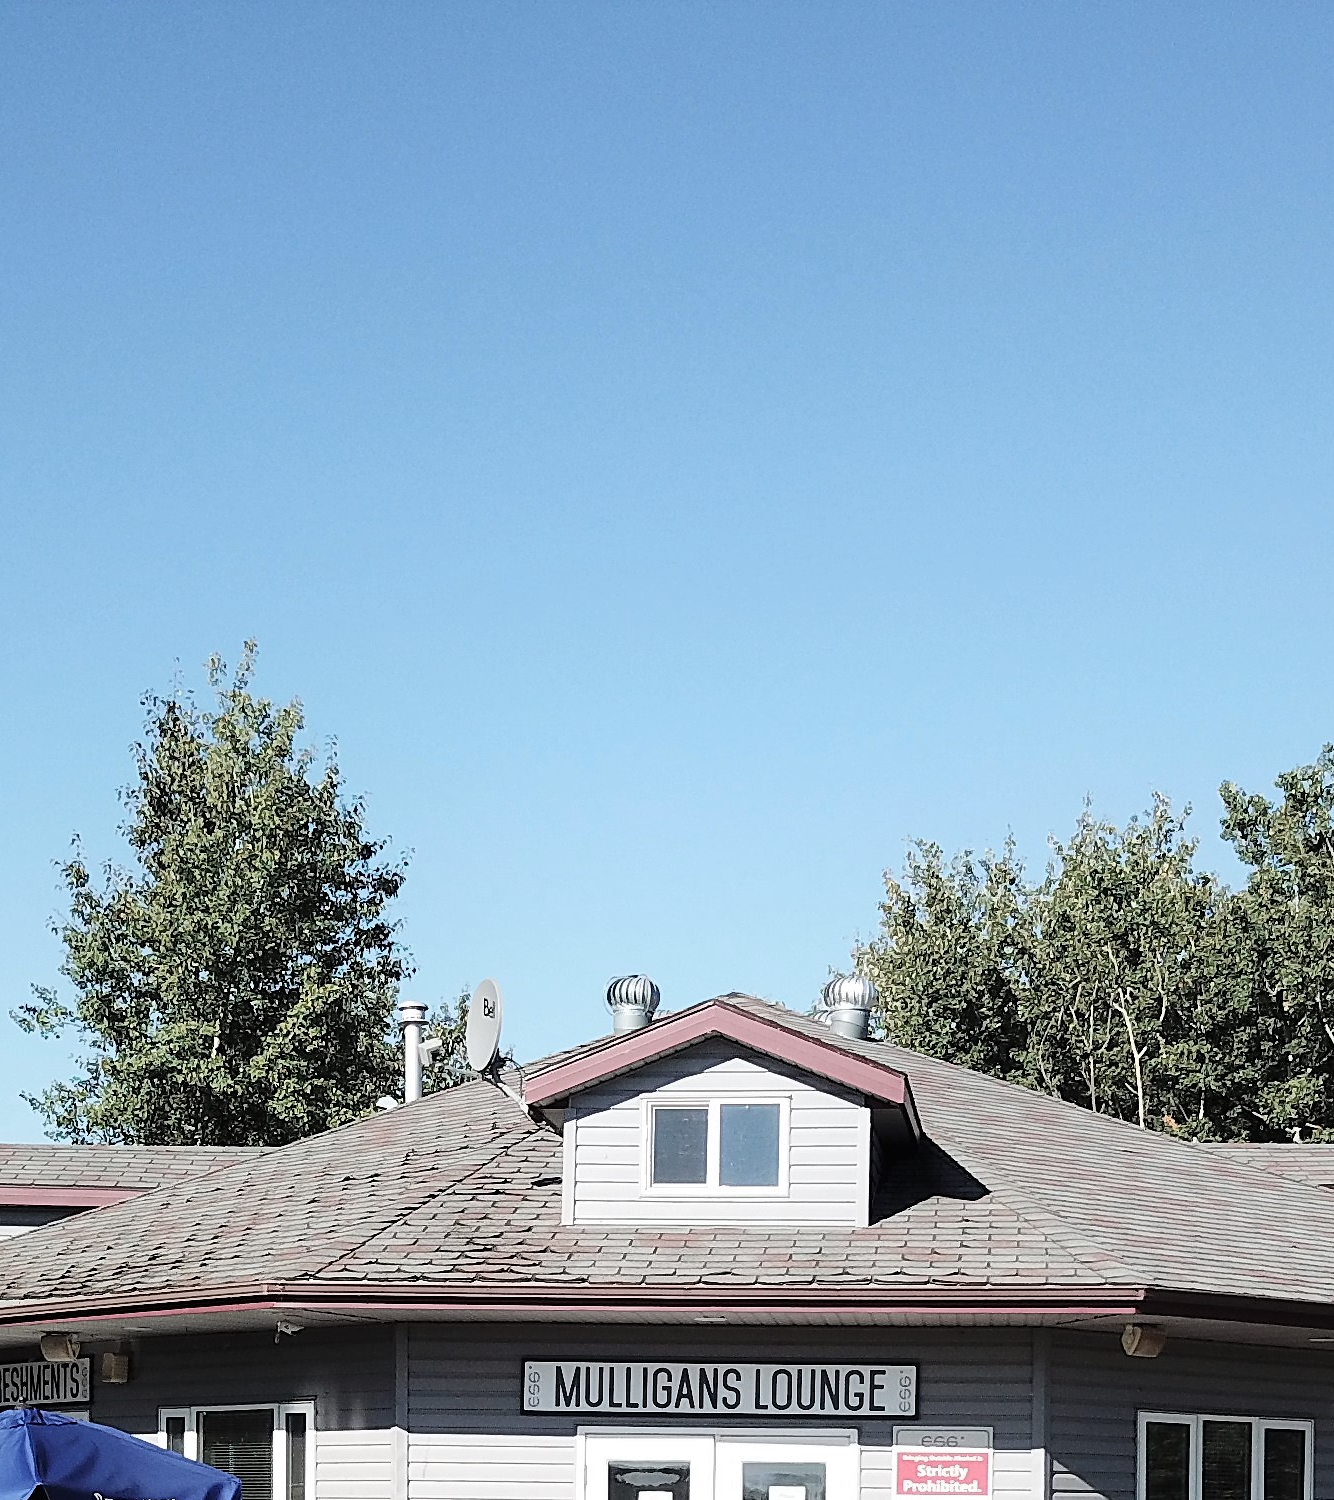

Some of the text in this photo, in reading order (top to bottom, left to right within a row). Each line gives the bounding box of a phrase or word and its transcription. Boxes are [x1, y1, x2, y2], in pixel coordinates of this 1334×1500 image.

[554, 1365, 887, 1413] MULLIGANS LOUNGE
[916, 1464, 969, 1480] Strictly
[902, 1480, 983, 1493] Prohibited.
